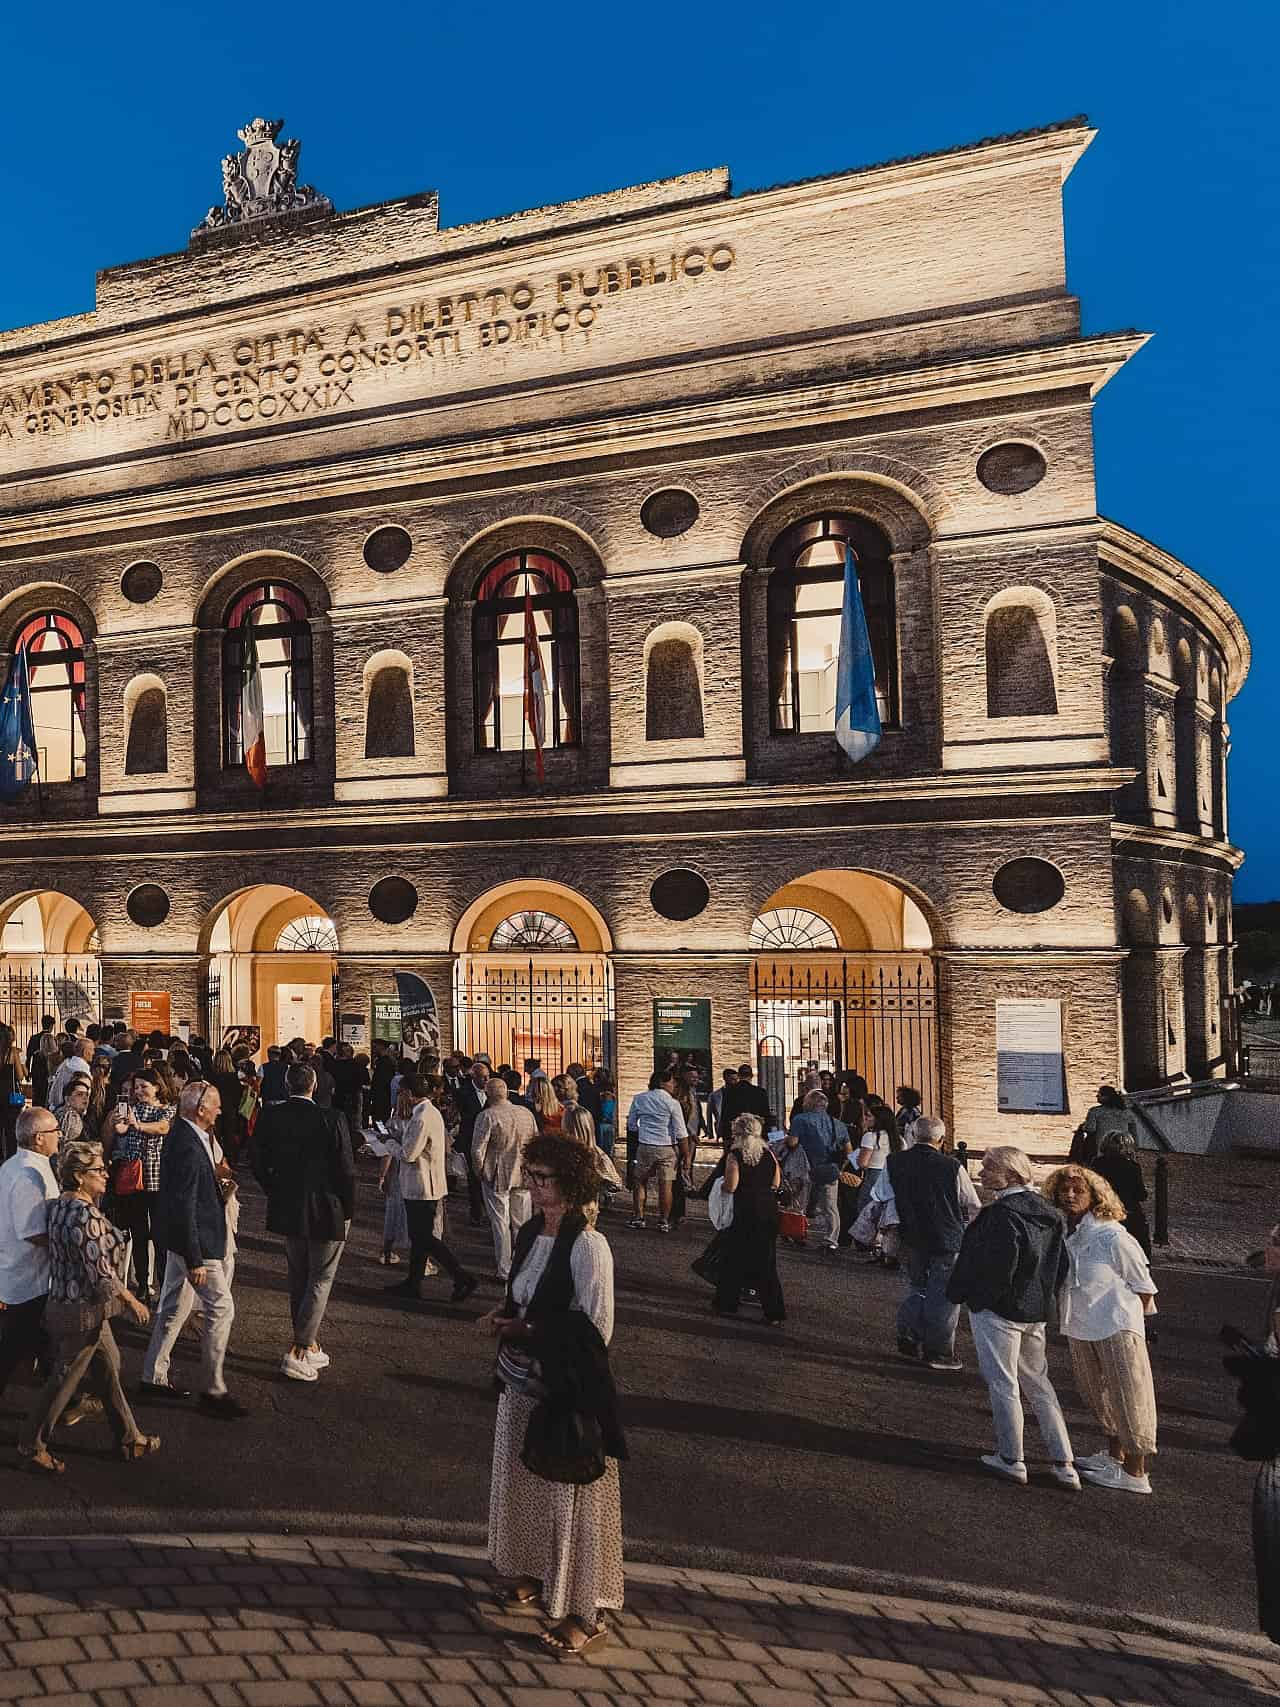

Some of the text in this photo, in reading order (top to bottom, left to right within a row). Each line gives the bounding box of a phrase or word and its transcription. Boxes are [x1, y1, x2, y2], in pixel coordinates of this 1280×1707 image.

[131, 355, 217, 388] DELLA
[344, 321, 368, 346] A
[386, 282, 534, 338] DILETTO
[557, 243, 737, 303] PUBBLICO
[166, 378, 355, 438] MDCCCXXIX
[175, 384, 198, 408] DI
[215, 365, 300, 397] CENTO
[318, 330, 461, 377] CONSORTI
